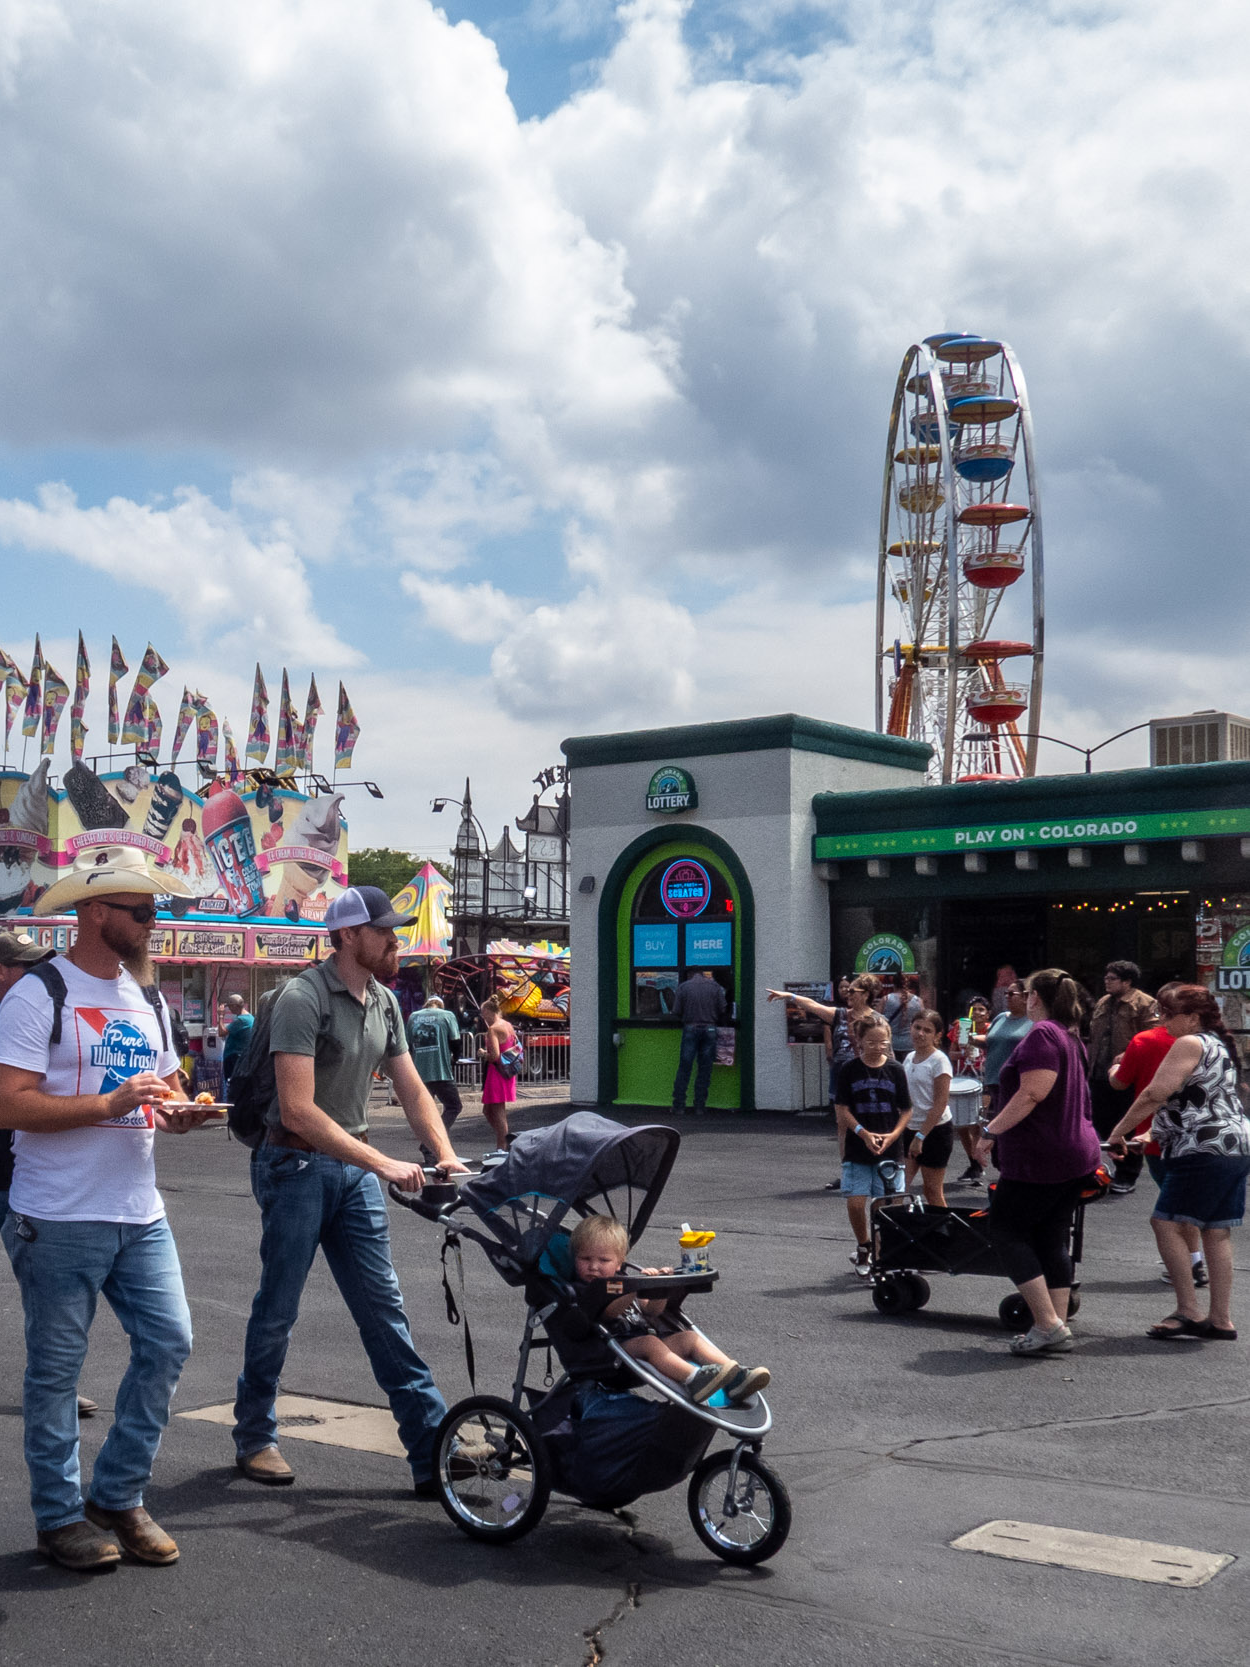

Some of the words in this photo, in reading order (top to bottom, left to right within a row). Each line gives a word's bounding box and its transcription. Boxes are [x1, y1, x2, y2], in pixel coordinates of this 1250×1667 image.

[654, 769, 684, 783] COLORADO
[647, 794, 690, 809] LOTTERY
[954, 829, 996, 845] PLAY
[1000, 827, 1025, 842] ON
[1039, 820, 1138, 840] COLORADO
[72, 830, 108, 849] CHEESECAKE
[116, 831, 130, 843] DEEP
[130, 834, 147, 848] FRIED
[147, 839, 165, 856] TREATS
[667, 887, 704, 899] SCRATCH
[202, 899, 226, 909] SNICKERS
[268, 946, 305, 956] CHEESECAKE
[645, 941, 666, 951] BUY
[693, 938, 724, 950] HERE
[862, 937, 908, 956] COLORADO
[108, 1028, 145, 1048] Pure
[93, 1046, 127, 1068] White
[129, 1048, 158, 1071] Trash
